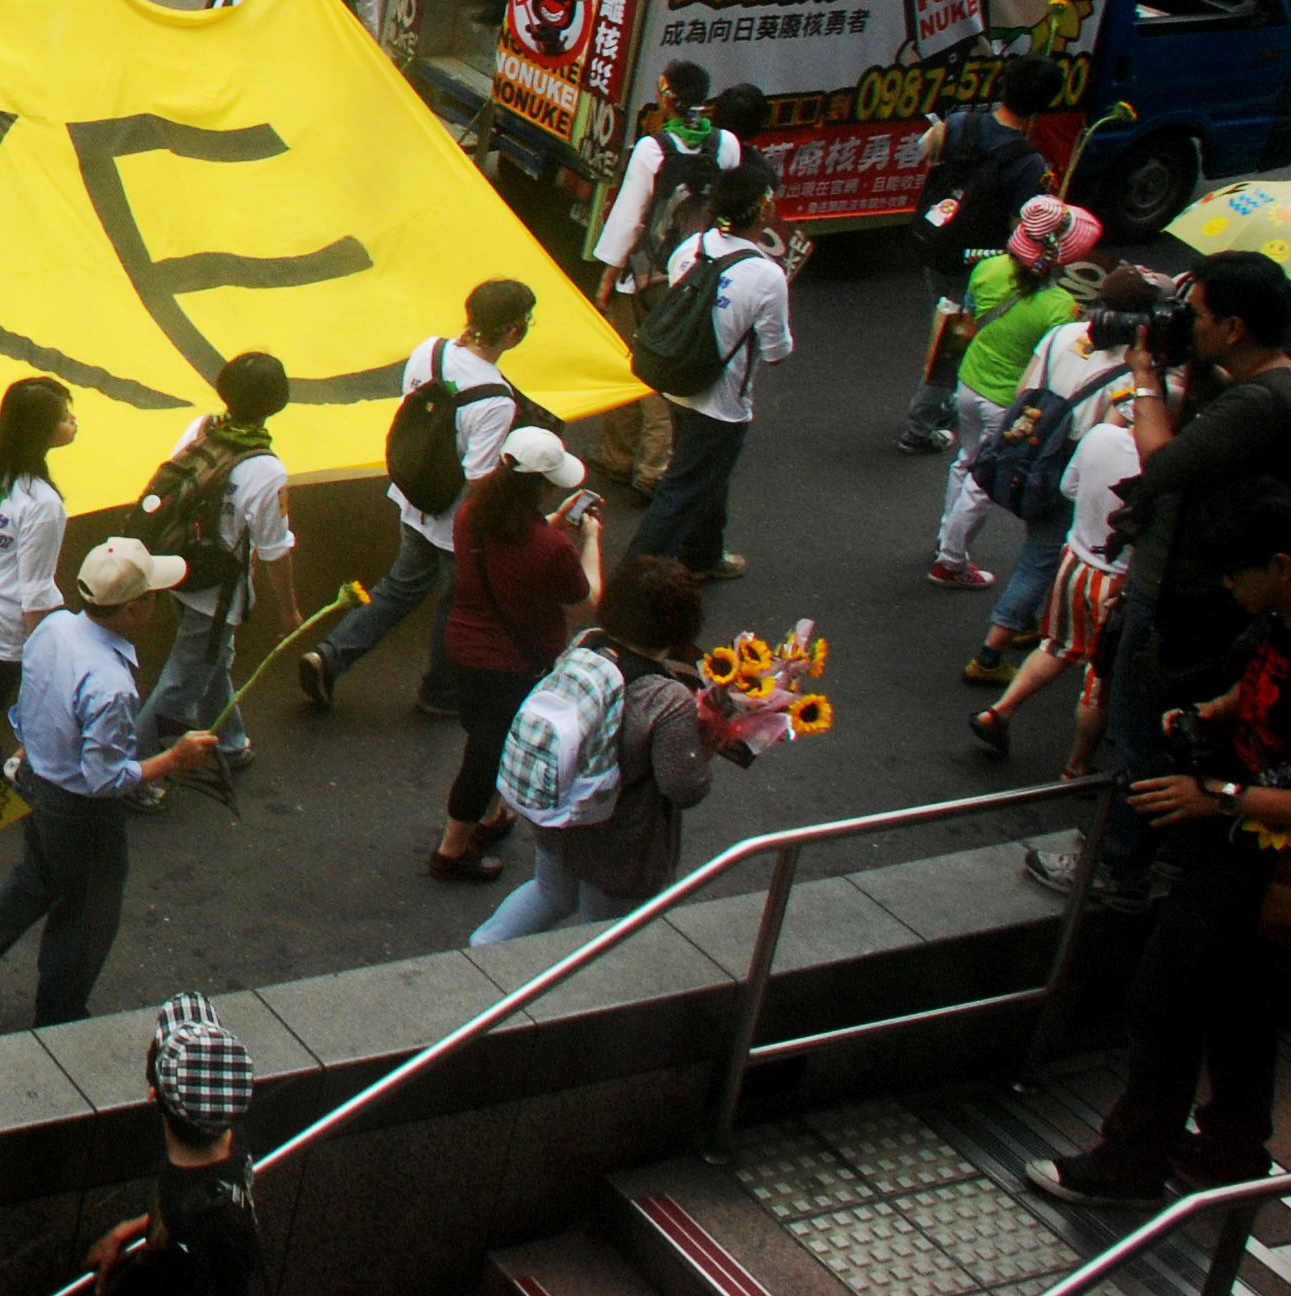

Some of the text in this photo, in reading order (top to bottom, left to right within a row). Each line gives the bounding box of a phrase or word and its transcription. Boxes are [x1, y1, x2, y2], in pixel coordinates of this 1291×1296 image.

[661, 8, 870, 48] 成為向日葵廢核勇者
